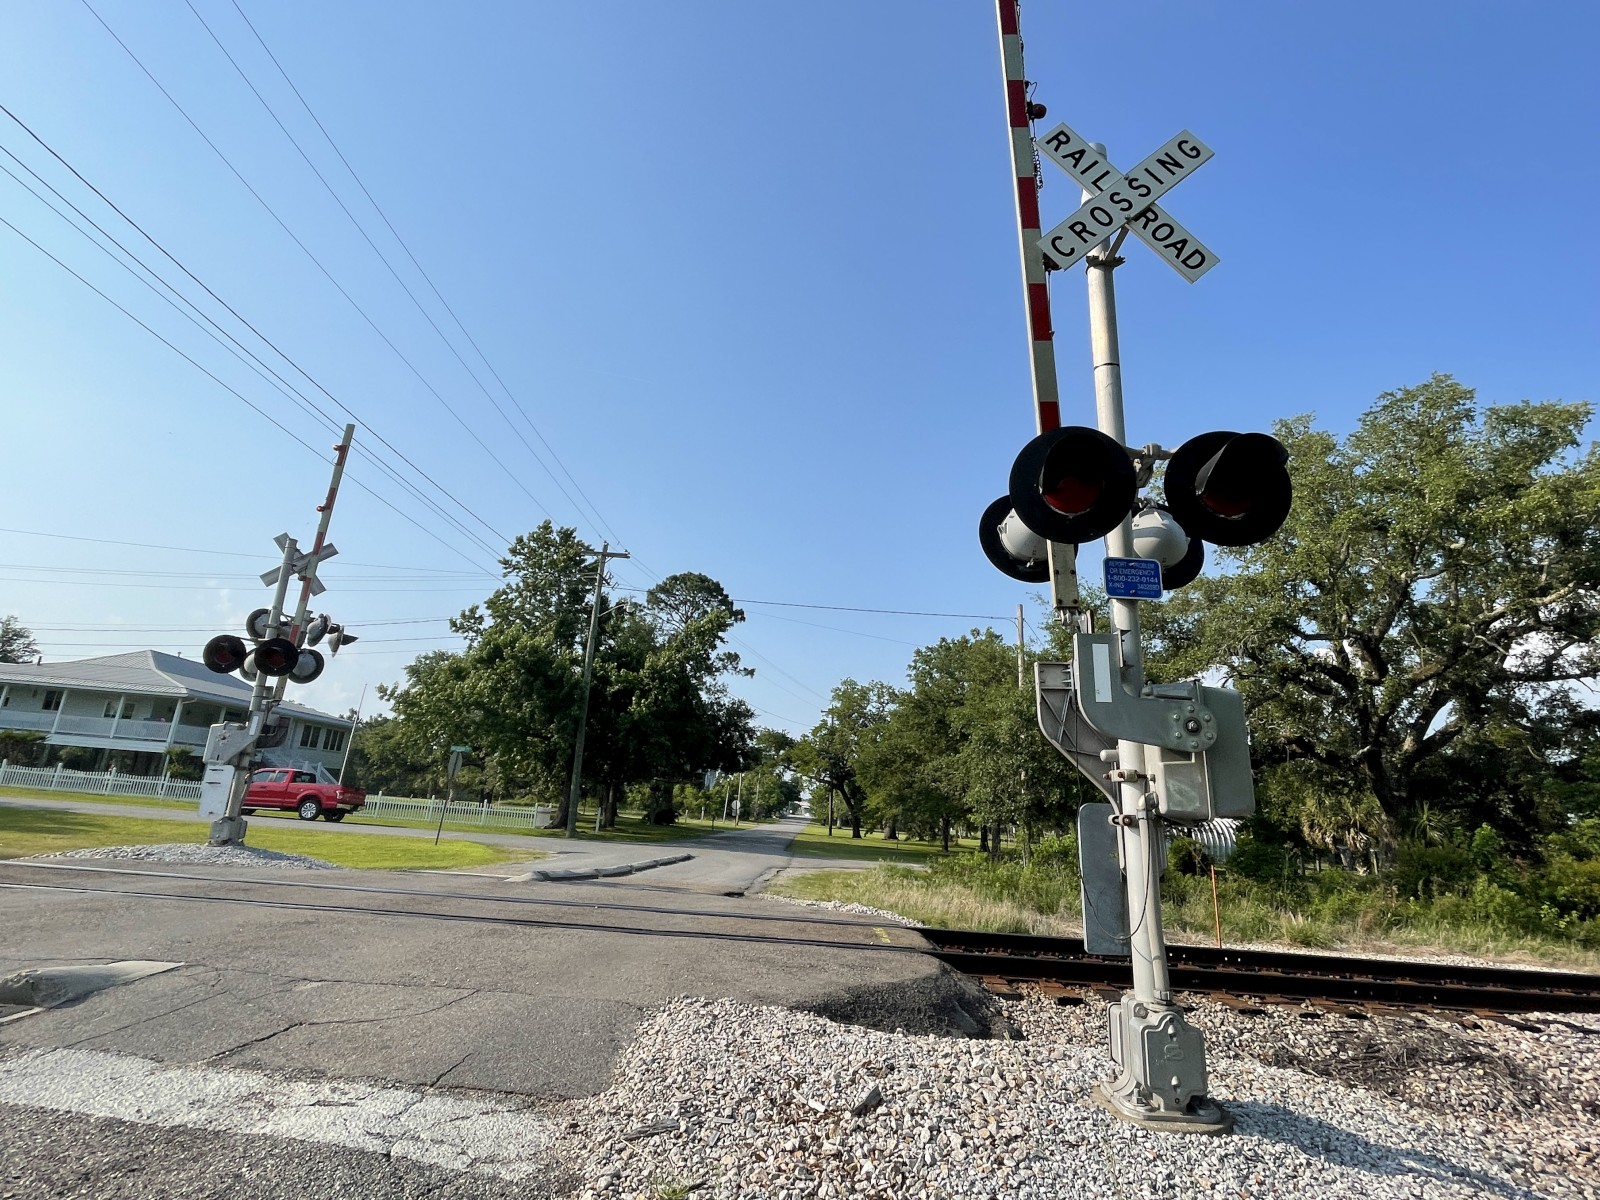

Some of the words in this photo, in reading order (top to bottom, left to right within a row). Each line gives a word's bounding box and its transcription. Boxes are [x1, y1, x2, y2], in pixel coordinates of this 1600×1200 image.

[1045, 130, 1111, 192] RAIL
[1133, 207, 1206, 270] ROAD
[1050, 140, 1201, 257] CROSSING
